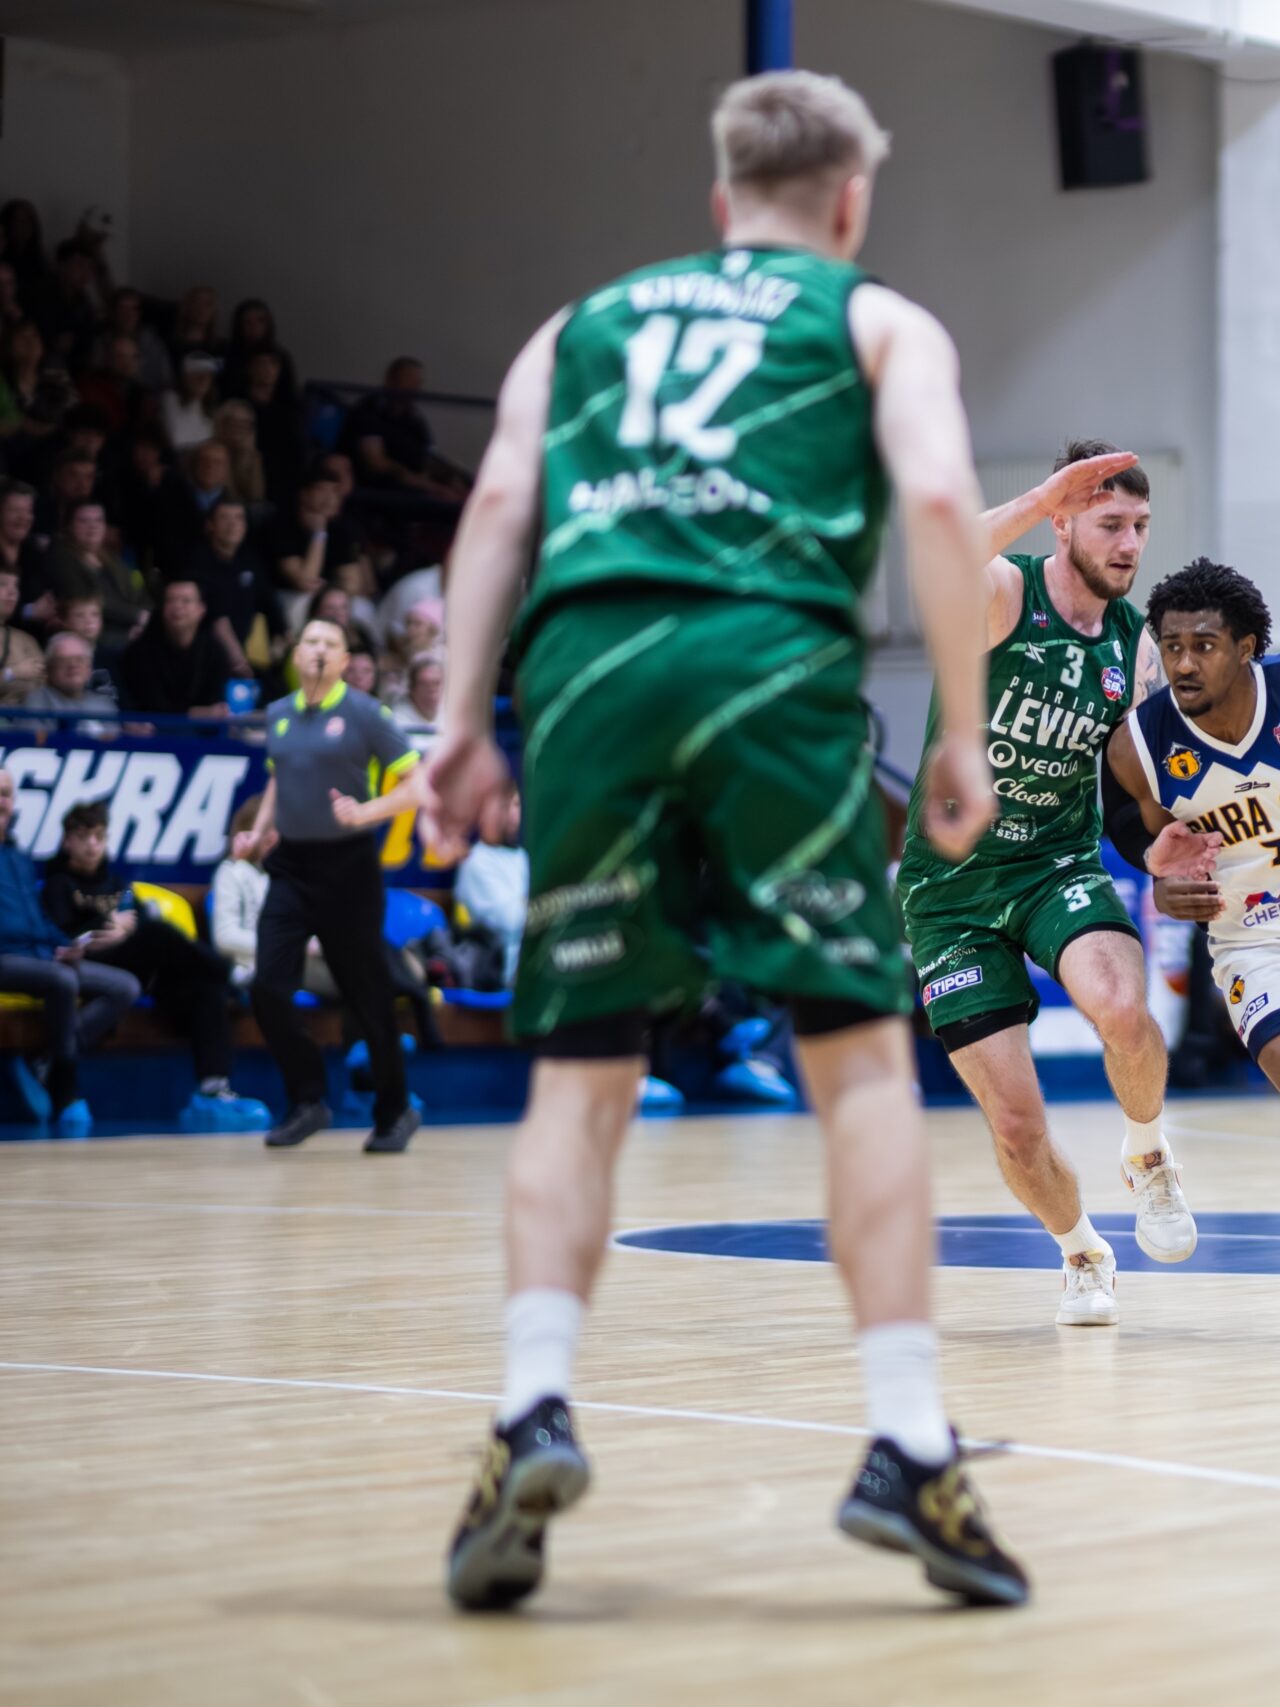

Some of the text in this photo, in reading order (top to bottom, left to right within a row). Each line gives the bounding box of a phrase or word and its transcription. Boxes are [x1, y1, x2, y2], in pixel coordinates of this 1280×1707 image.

[617, 313, 767, 461] 12
[1060, 644, 1086, 688] 3
[1009, 675, 1109, 720] PATRIOT
[1021, 755, 1078, 777] VEOLIA
[996, 829, 1028, 841] SEBO
[1064, 883, 1091, 912] 3
[931, 969, 979, 996] TIPOS
